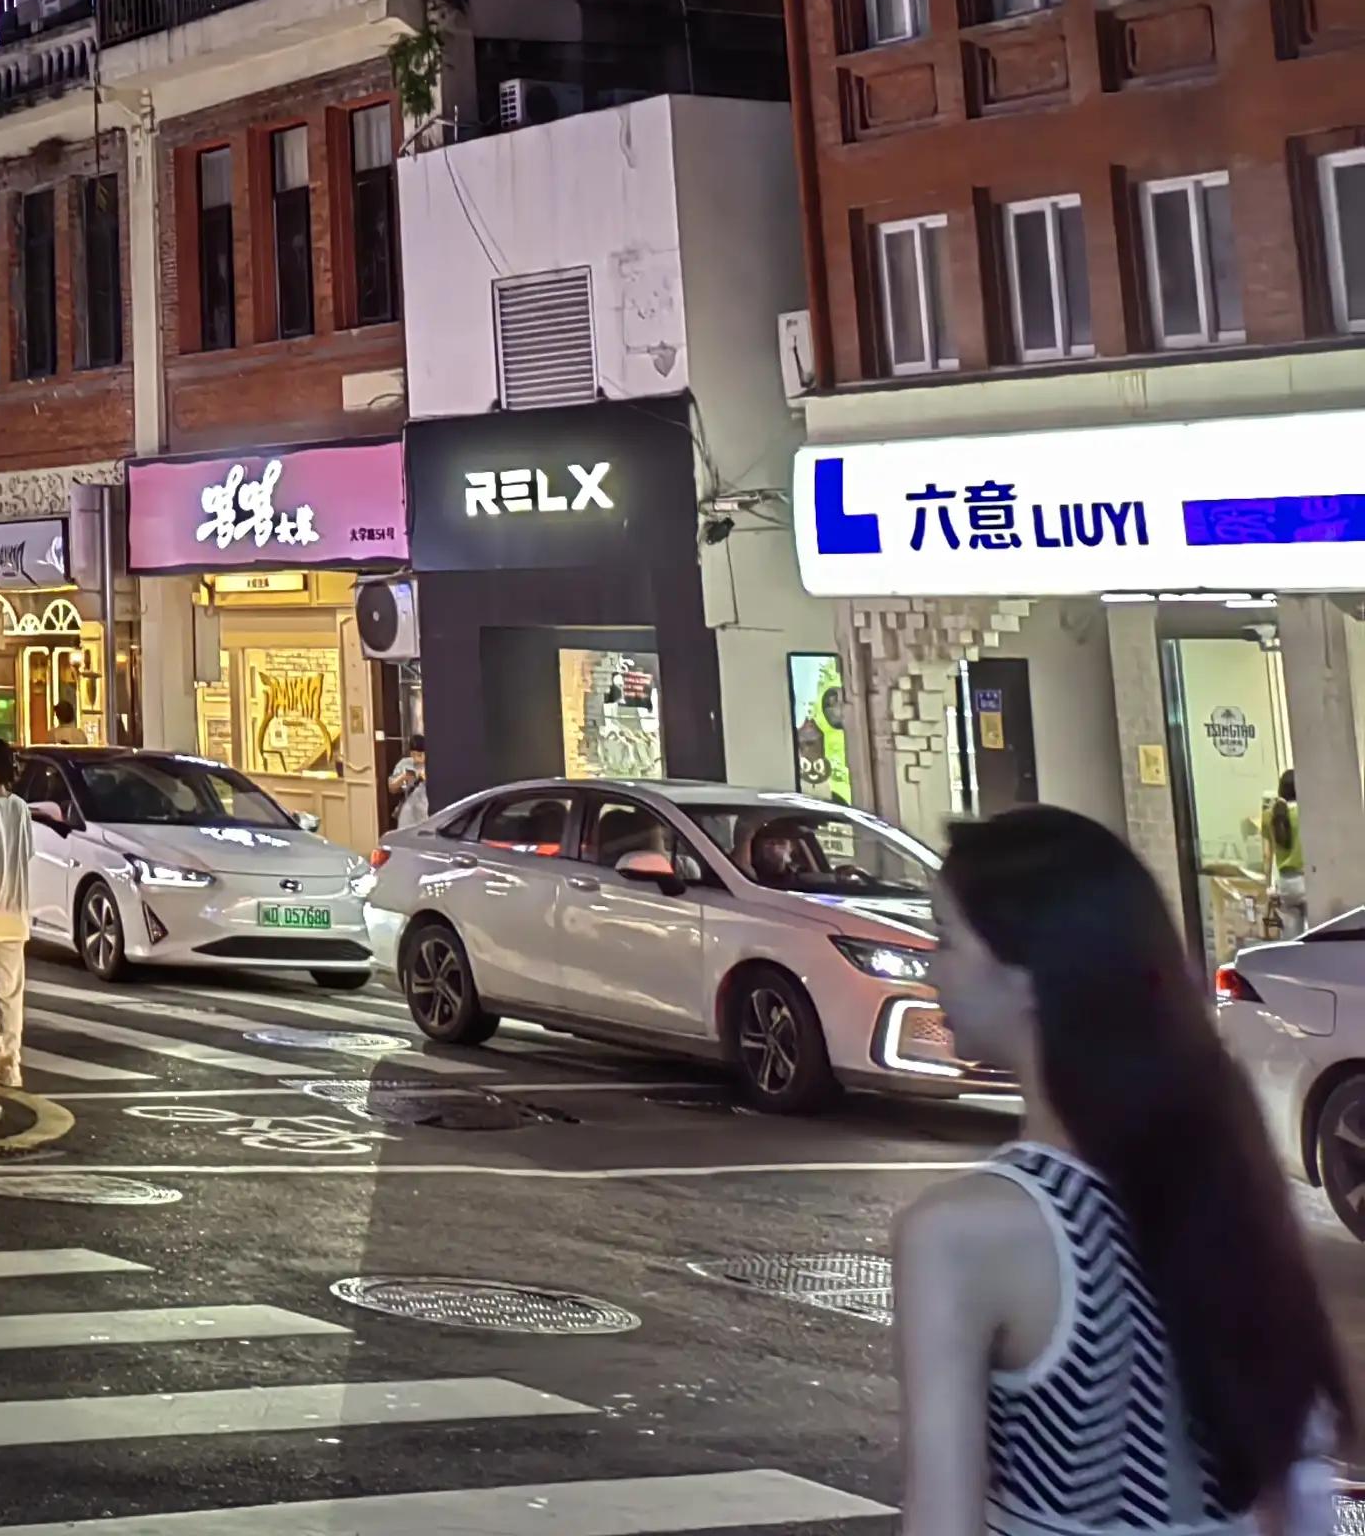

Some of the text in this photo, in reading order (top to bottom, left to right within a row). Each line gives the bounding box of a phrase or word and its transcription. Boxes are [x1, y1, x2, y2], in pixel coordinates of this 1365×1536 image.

[464, 462, 614, 516] RELX
[906, 479, 1149, 552] 六意 LIUYI
